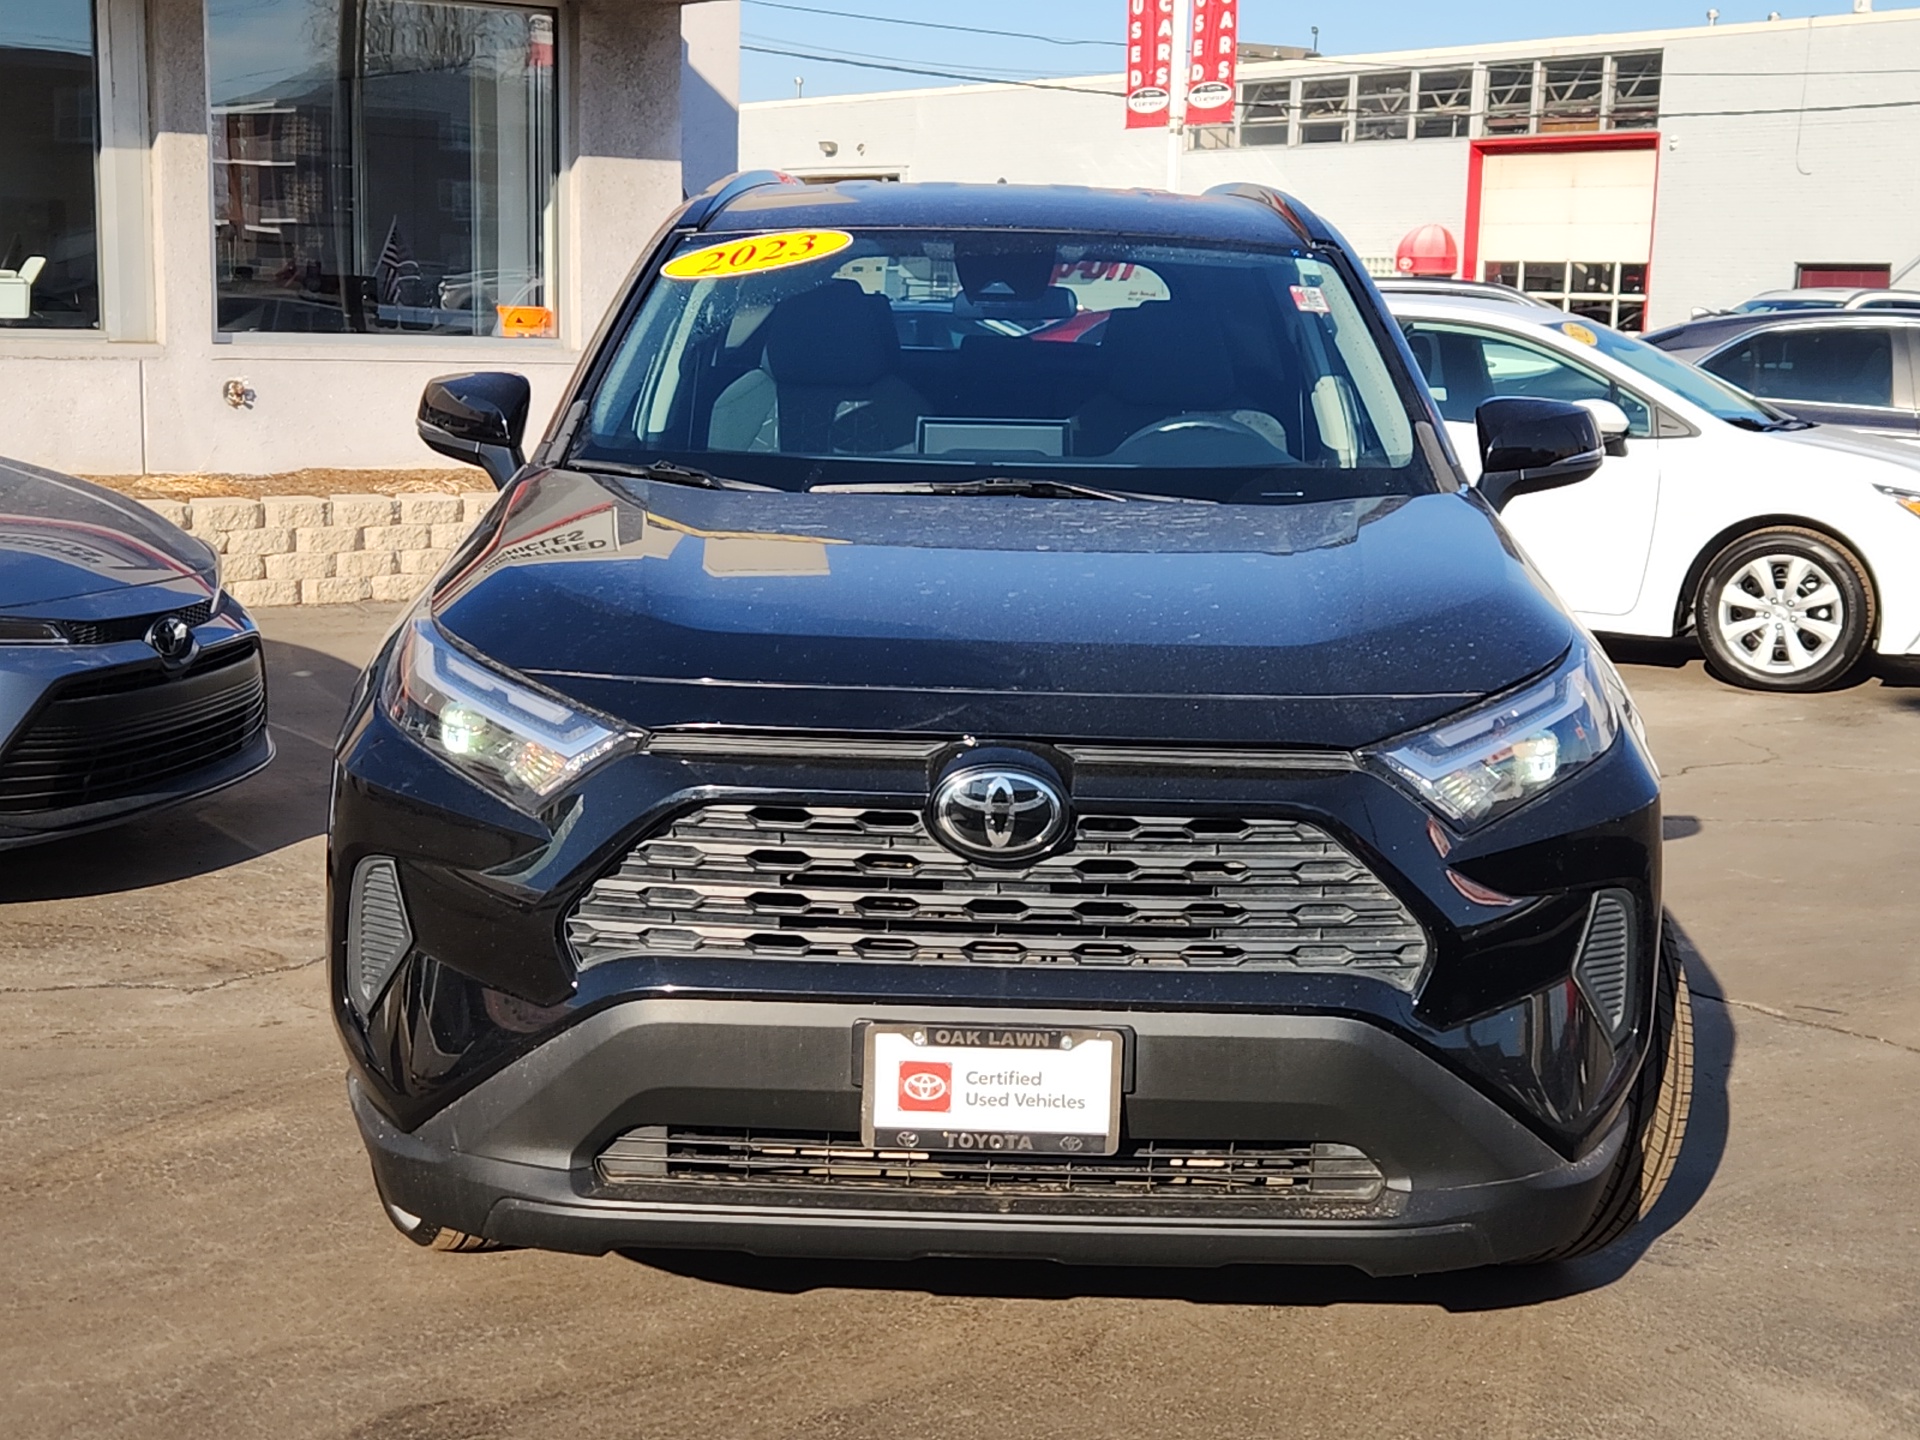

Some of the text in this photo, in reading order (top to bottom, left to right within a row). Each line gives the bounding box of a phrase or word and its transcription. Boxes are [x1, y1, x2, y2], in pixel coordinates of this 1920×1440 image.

[1130, 0, 1172, 87] USED CARS
[1218, 0, 1234, 79] ARS
[696, 234, 818, 274] 2023
[935, 1029, 1050, 1048] OAK LAWN
[965, 1070, 1043, 1087] Certified
[965, 1092, 1087, 1110] Used Vehicles
[946, 1133, 1034, 1150] TOYOTA
